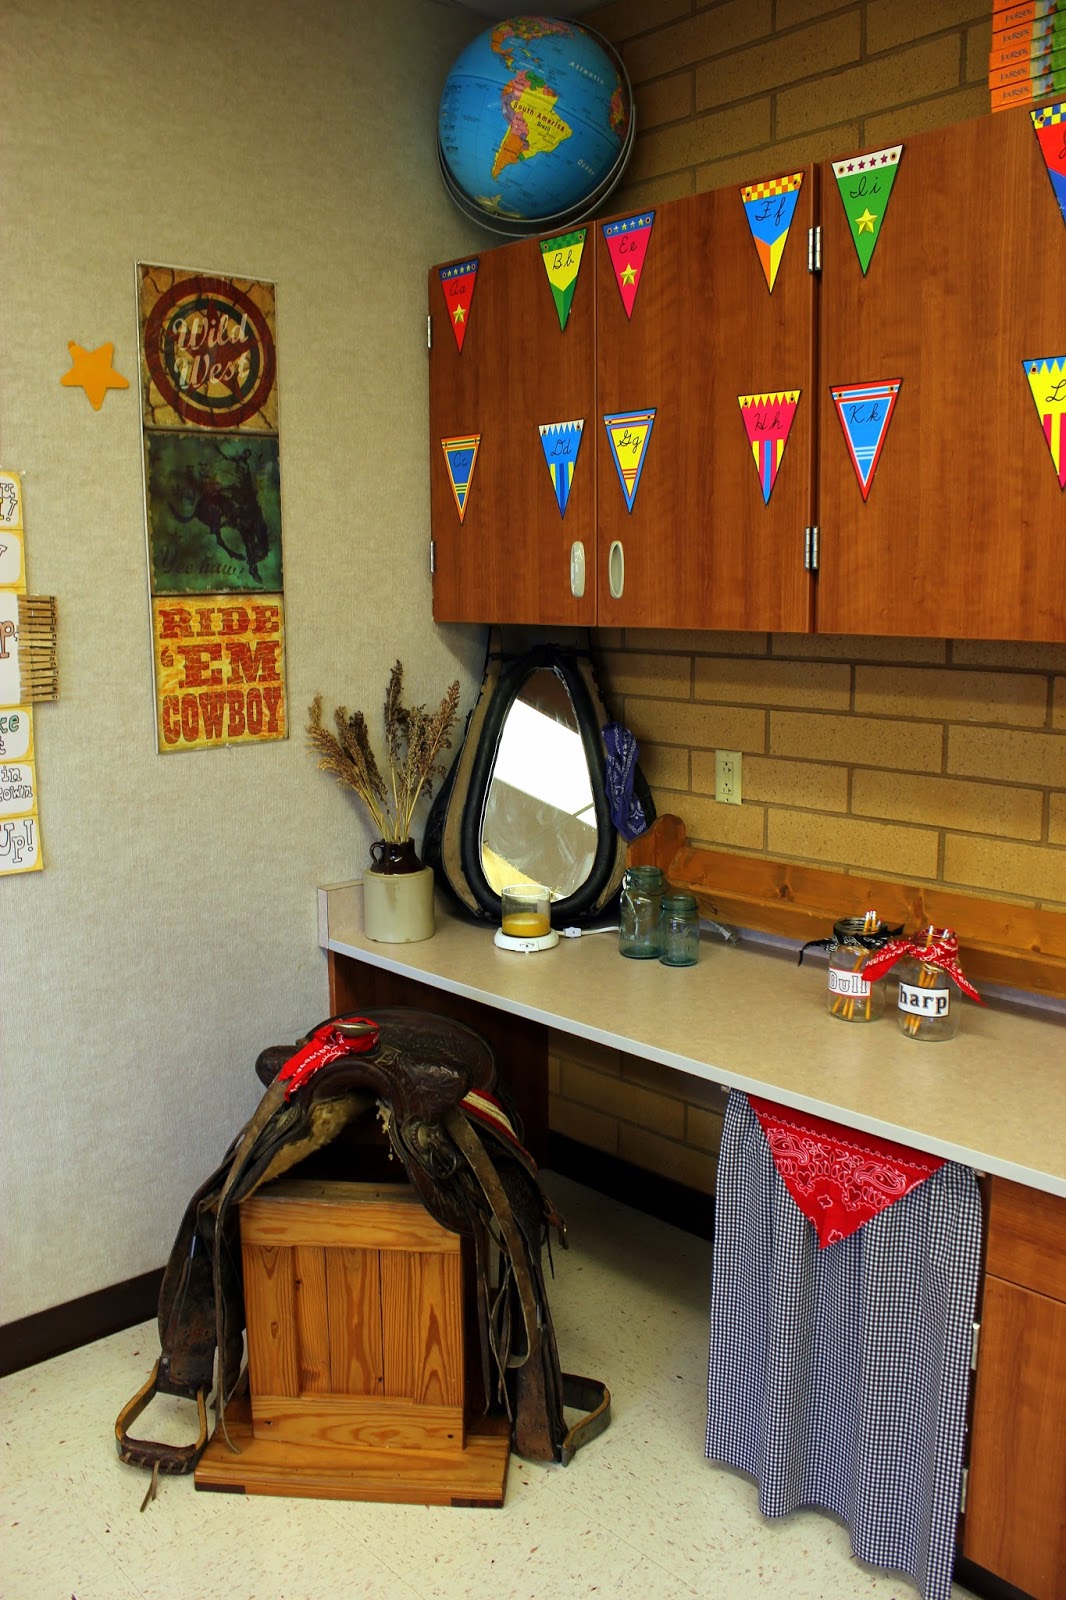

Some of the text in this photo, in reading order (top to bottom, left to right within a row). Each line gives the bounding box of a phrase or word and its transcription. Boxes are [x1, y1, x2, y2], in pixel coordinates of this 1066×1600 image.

[513, 101, 566, 133] South America
[536, 121, 551, 132] Brazil
[172, 313, 249, 350] Wild
[173, 352, 250, 389] West
[158, 605, 280, 639] RIDE
[162, 687, 282, 744] COWBOY
[829, 971, 868, 994] Dull
